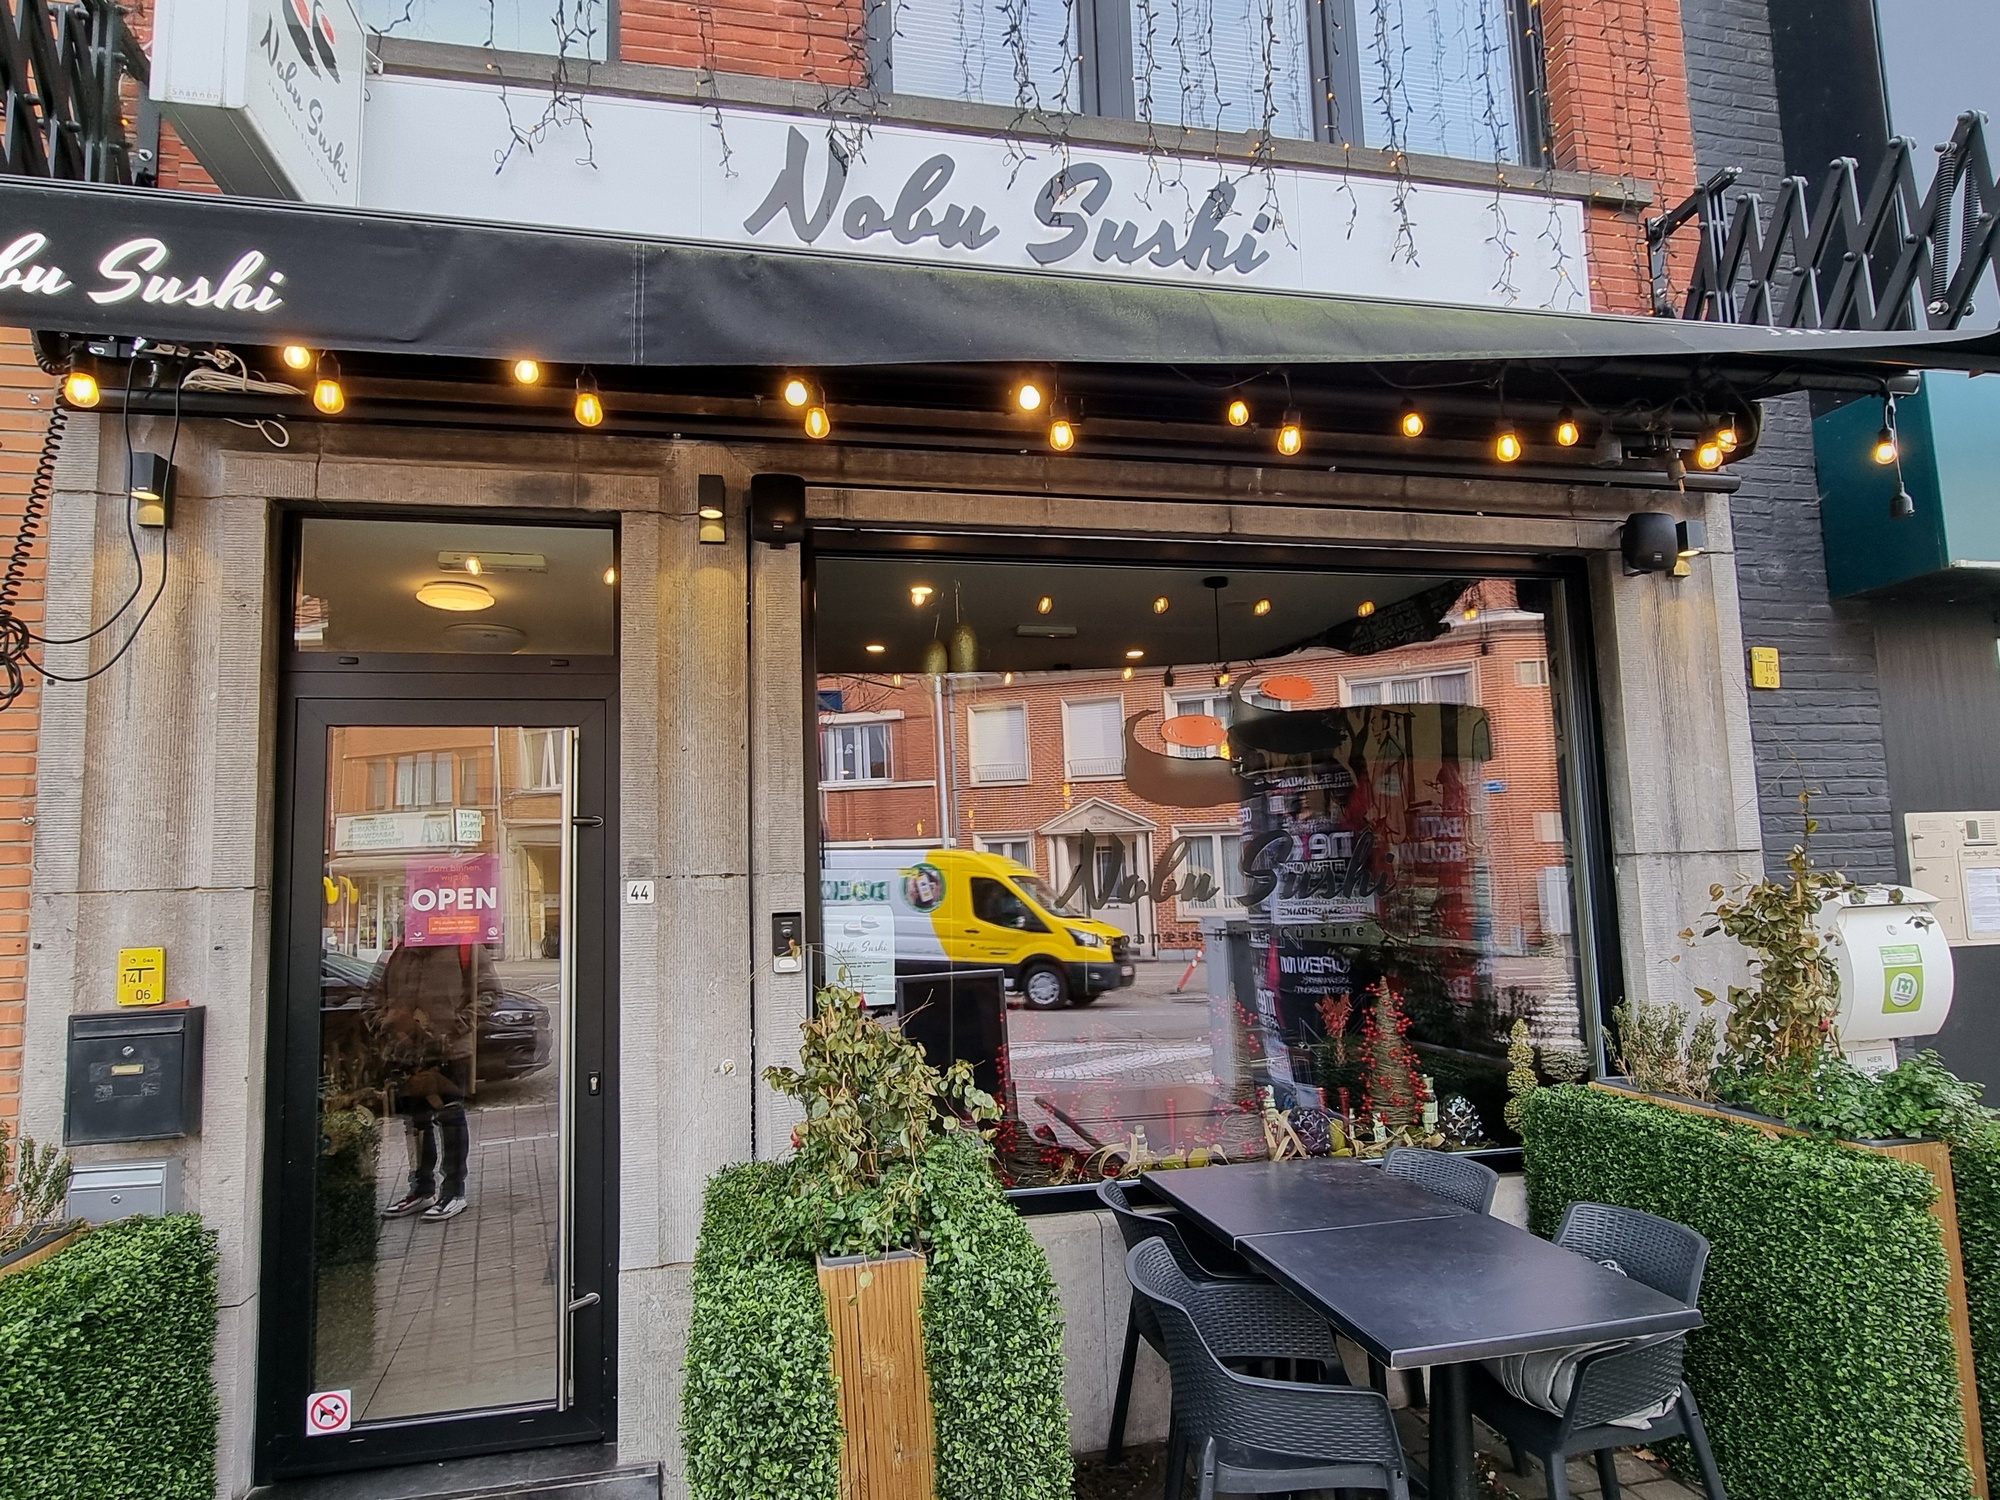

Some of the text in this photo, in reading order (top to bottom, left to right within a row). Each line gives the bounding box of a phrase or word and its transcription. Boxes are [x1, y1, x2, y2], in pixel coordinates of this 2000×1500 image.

[171, 87, 220, 100] Shannon
[259, 11, 303, 112] Nobu
[306, 98, 348, 184] Sushi
[743, 125, 1271, 275] Nobu Sushi
[87, 237, 285, 312] Sushi
[1940, 840, 1946, 848] 3
[1054, 827, 1397, 910] Nobu Sushi
[1944, 875, 1950, 883] 2
[411, 886, 498, 912] OPEN
[630, 884, 649, 901] 44
[1281, 925, 1367, 940] Cuisine
[122, 973, 136, 984] 14
[135, 989, 151, 1000] 06
[1866, 1055, 1883, 1063] HIER
